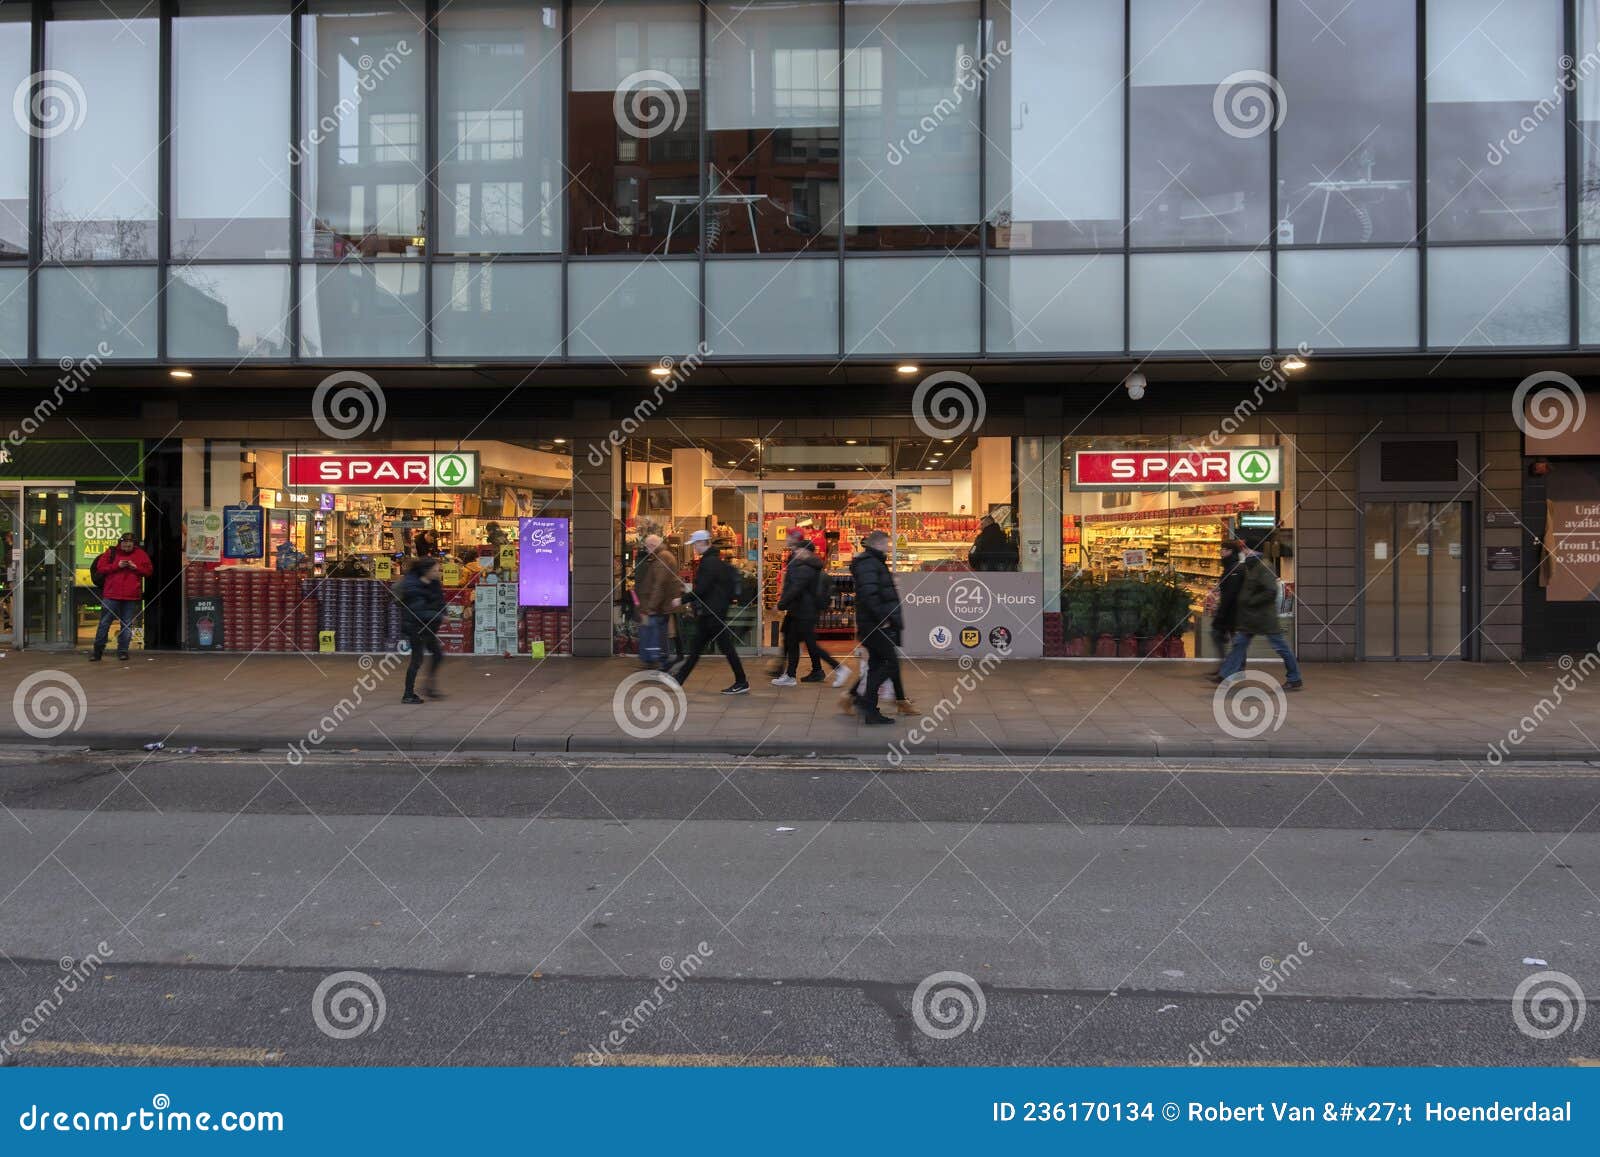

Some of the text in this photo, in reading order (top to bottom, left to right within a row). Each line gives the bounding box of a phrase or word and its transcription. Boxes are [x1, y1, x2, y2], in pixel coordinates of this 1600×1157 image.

[319, 461, 427, 479] SPAR
[1111, 458, 1227, 477] SPAR
[84, 512, 122, 527] BEST
[84, 528, 123, 539] ODDS
[905, 586, 1036, 608] Open 24 Hours
[955, 605, 984, 614] hours
